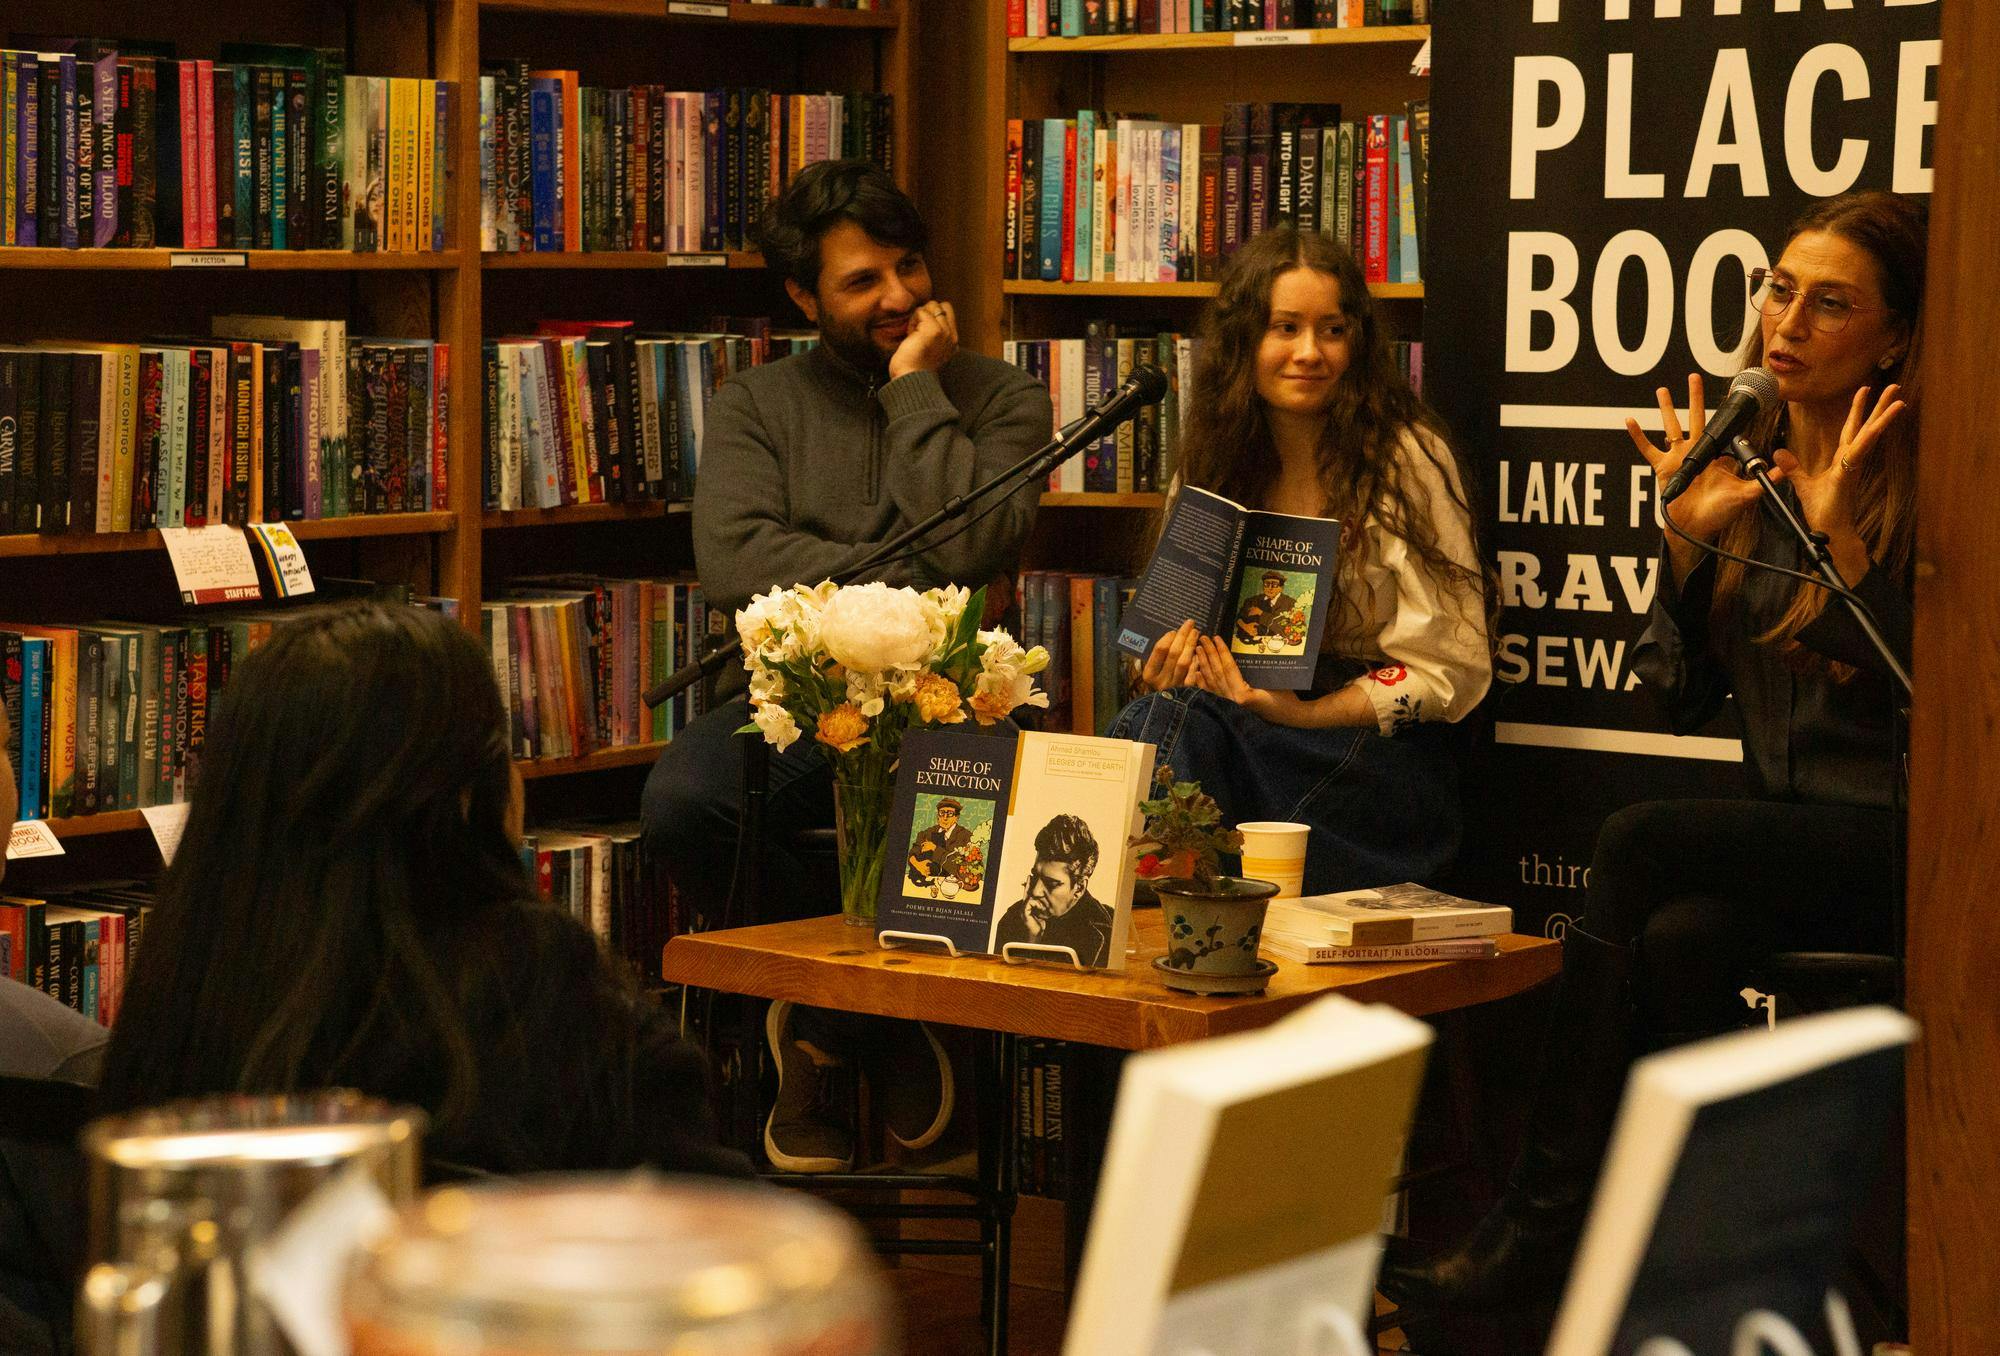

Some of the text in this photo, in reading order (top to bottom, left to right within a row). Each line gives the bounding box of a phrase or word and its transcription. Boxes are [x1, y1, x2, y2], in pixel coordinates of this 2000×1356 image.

[24, 78, 37, 214] THE BEAUTIFUL MADDENING
[101, 71, 114, 218] A STEEPING OF BLOOD
[1281, 131, 1292, 160] INTO
[1510, 40, 1942, 199] PLACE
[79, 95, 92, 219] A TEMPEST OF TEA
[239, 139, 251, 178] RISE
[325, 92, 338, 221] DRYAD STORM
[392, 129, 401, 226] GILDED ONES
[505, 107, 520, 213] MOONSTORM
[615, 125, 623, 177] MASTER
[691, 162, 699, 192] YEAR
[1252, 166, 1263, 191] HOLY
[65, 176, 76, 227] EVERYTHING
[556, 186, 563, 199] US
[1132, 185, 1140, 230] loveless
[1148, 185, 1157, 230] loveless
[1226, 168, 1238, 244] HOLY TERRORS
[1280, 177, 1292, 213] LIGHT
[1300, 156, 1314, 207] DARK
[275, 205, 286, 219] IN
[1007, 191, 1015, 249] FACTOR
[1042, 192, 1058, 237] GIRLS
[1162, 168, 1174, 261] RADIO SILENCE
[1203, 176, 1216, 252] PAINTED DEVILS
[1369, 165, 1381, 258] FAKE SKATING
[1505, 229, 1770, 377] BOO
[121, 354, 131, 455] CANTO CONTIGO
[322, 373, 330, 403] woods
[511, 394, 516, 409] we
[1086, 371, 1100, 406] TOUCH
[0, 414, 16, 476] CARAVAL
[212, 395, 225, 487] GIRL IN PIECES
[236, 380, 251, 482] MONARCH RISING
[309, 377, 319, 482] THROWBACK
[320, 406, 328, 428] took
[337, 406, 345, 428] took
[437, 392, 448, 489] CHAOS FLAME
[487, 360, 498, 496] LAST NIGHT TELEGRAPH CLUB
[537, 376, 554, 460] FOREVER NOW
[605, 384, 619, 455] ICON INFERNO
[669, 400, 679, 472] PRODIGY
[81, 420, 99, 476] FINALE
[158, 423, 170, 498] GLASS GIRL
[511, 446, 519, 473] liars
[588, 432, 598, 473] UNICORN
[1499, 460, 1605, 526] LAKE
[1223, 520, 1245, 592] SHAPE EXTINCTION
[1246, 549, 1323, 566] EXTINCTION
[1255, 536, 1314, 553] SHAPE OF
[224, 587, 260, 600] STAFF PICK
[1497, 551, 1659, 614] RAV
[161, 645, 173, 782] KIND BIG DEAL
[176, 670, 187, 752] MOONSTORM
[191, 652, 206, 747] STARSTRIKE
[65, 722, 75, 769] WORST
[87, 697, 97, 789] AMONG SERPENTS
[107, 720, 116, 766] SKY'S END
[145, 700, 157, 760] HOLLOW
[916, 771, 1001, 791] EXTINCTION
[930, 756, 992, 774] SHAPE OF
[1048, 757, 1075, 767] ELEGIES
[1088, 761, 1100, 769] THE
[1102, 762, 1124, 771] EARTH
[9, 829, 38, 839] ANNED
[11, 834, 43, 847] BOOK
[935, 906, 952, 914] BIJAN
[1316, 949, 1389, 959] SELF-PORTRAIT
[1392, 949, 1401, 957] IN
[1045, 1064, 1063, 1141] POWERLESS
